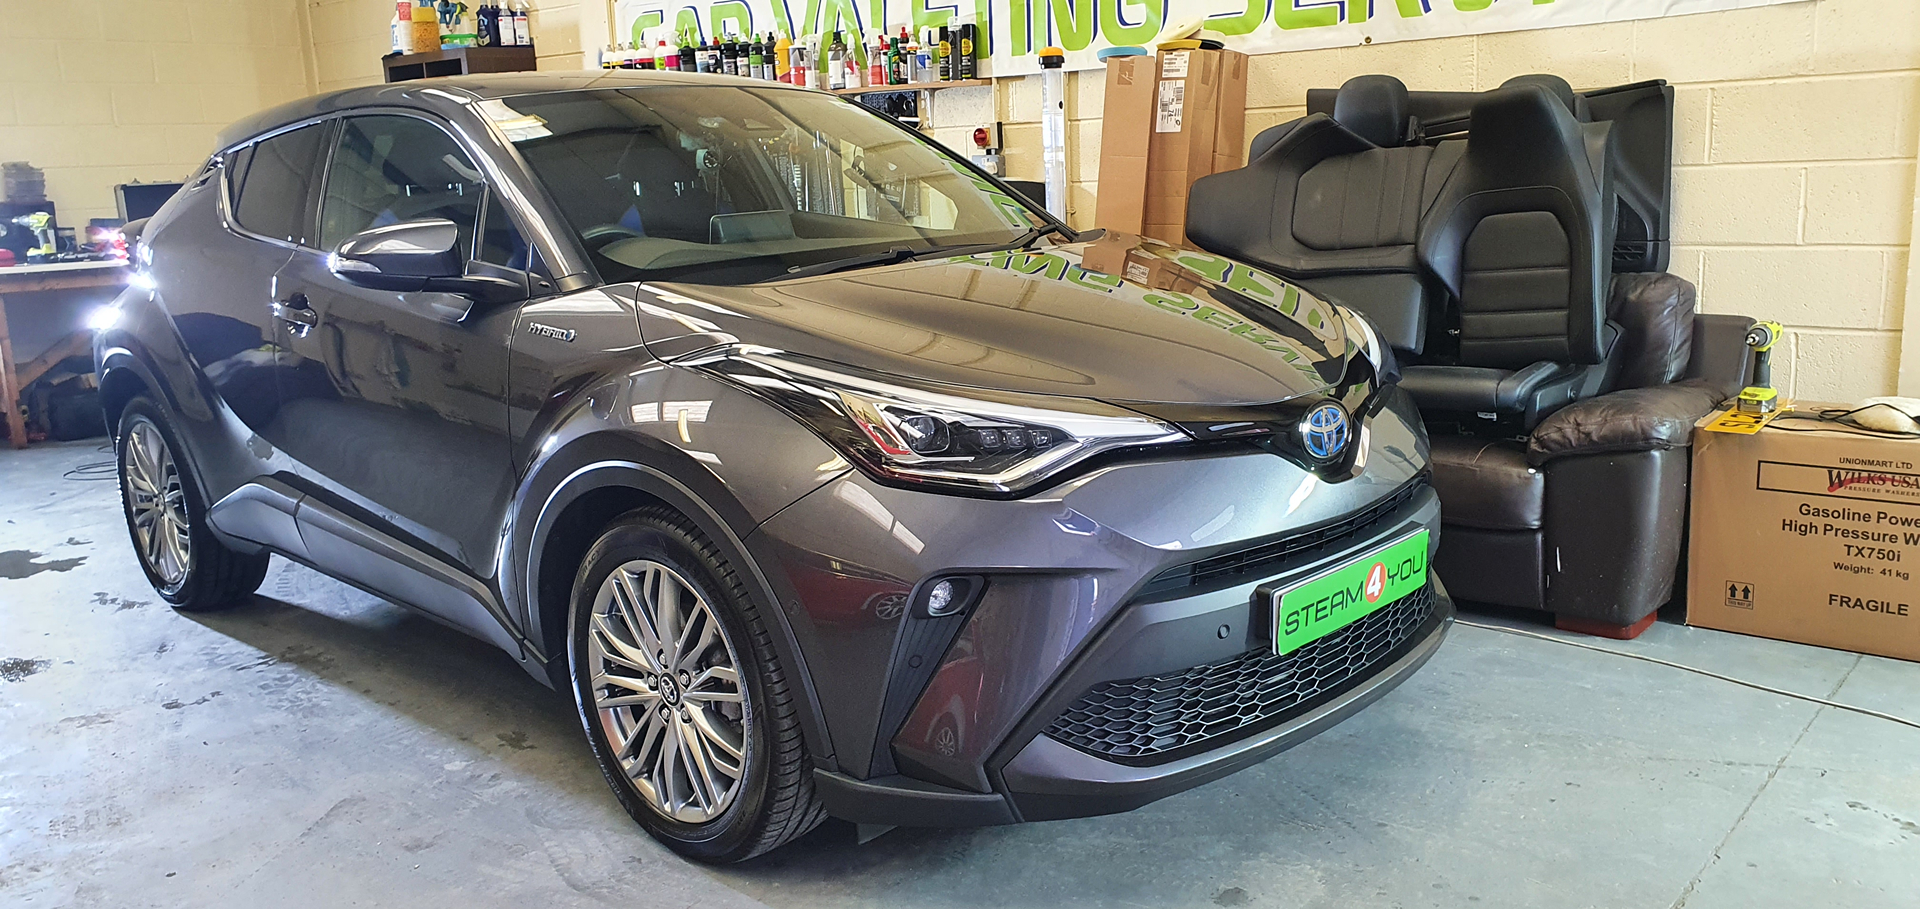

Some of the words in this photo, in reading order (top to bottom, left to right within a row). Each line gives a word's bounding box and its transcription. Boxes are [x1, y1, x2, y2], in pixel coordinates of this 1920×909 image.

[528, 321, 568, 341] HYBRID
[1839, 456, 1893, 468] UNIONMART
[1895, 461, 1913, 469] LTD
[1827, 469, 1886, 488] WILKS
[1891, 475, 1920, 490] USA
[1844, 485, 1881, 494] PRESSURE
[1799, 503, 1872, 523] Gasoline
[1876, 511, 1920, 529] Powe
[1782, 518, 1819, 537] High
[1823, 523, 1899, 544] Pressure
[1843, 544, 1901, 562] TX750i
[1833, 561, 1874, 575] Weight:
[1879, 567, 1892, 577] 41
[1895, 570, 1910, 581] kg
[1828, 593, 1909, 617] FRAGILE
